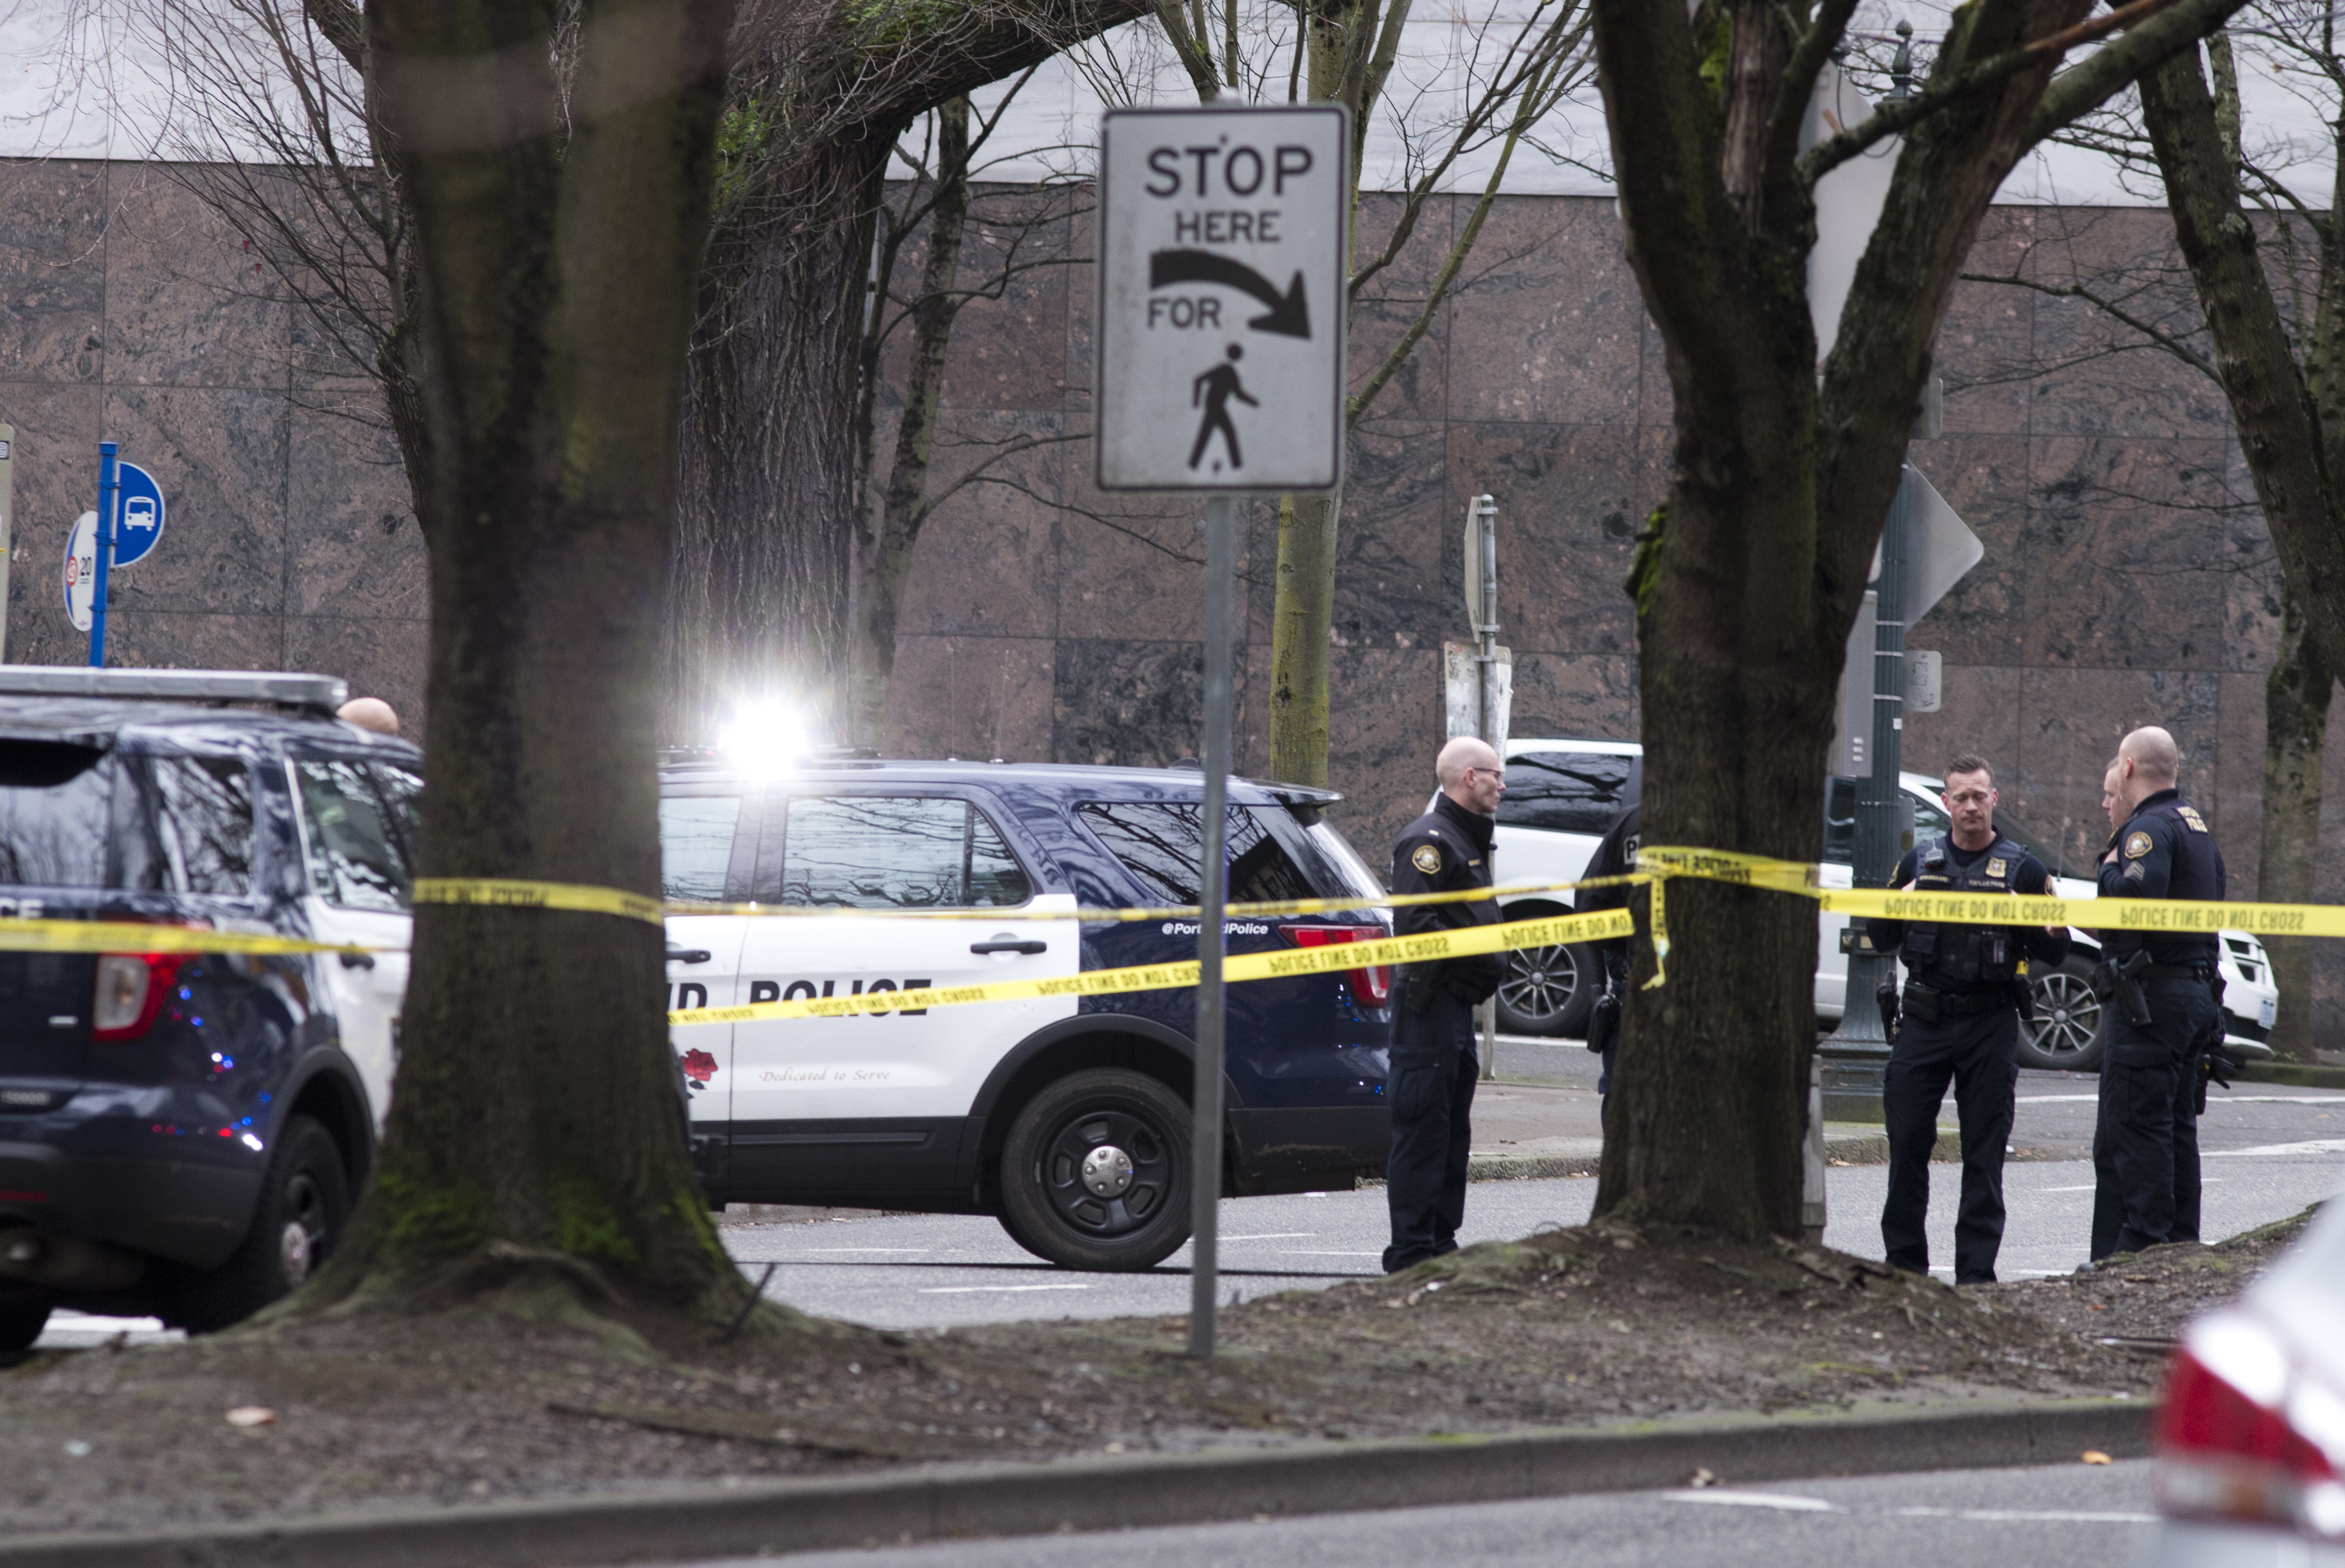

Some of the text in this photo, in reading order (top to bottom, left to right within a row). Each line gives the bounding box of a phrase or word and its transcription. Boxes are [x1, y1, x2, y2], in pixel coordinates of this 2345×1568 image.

[1144, 145, 1313, 198] STOP
[1174, 210, 1282, 243] HERE
[1147, 297, 1221, 329] FOR
[80, 556, 92, 576] 20
[1162, 923, 1269, 935] @PortdPolice
[749, 979, 932, 1017] POLICE
[759, 1066, 890, 1082] Dedicated to Serve
